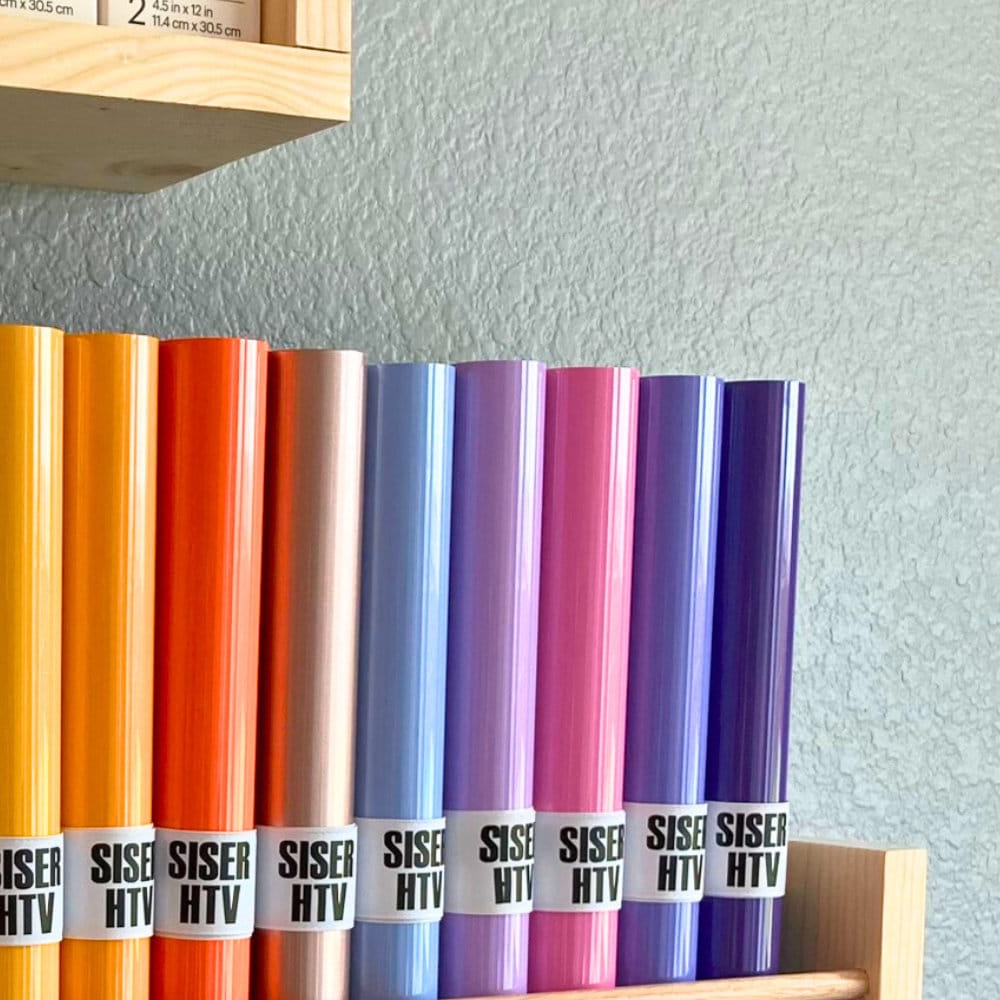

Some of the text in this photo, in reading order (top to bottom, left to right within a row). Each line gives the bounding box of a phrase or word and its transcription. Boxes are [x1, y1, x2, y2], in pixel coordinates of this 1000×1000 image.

[0, 0, 17, 8] cm
[29, 0, 53, 12] 30.5
[56, 5, 74, 15] cm
[128, 0, 145, 25] 2
[152, 0, 169, 12] 4.5
[171, 3, 180, 13] in
[191, 5, 202, 16] 12
[204, 6, 213, 17] in
[152, 15, 241, 37] 11.4 cm x 30.5 cm
[480, 824, 534, 862] SISE
[716, 812, 786, 847] SISER
[169, 841, 249, 880] SISER
[278, 839, 353, 878] SISER
[658, 853, 702, 891] HTV
[727, 852, 780, 887] HTV
[292, 883, 347, 921] HTV
[397, 872, 441, 910] HTV
[494, 865, 533, 903] HTV
[572, 866, 619, 904] HTV
[106, 888, 153, 928] HTV
[180, 885, 240, 924] HTV
